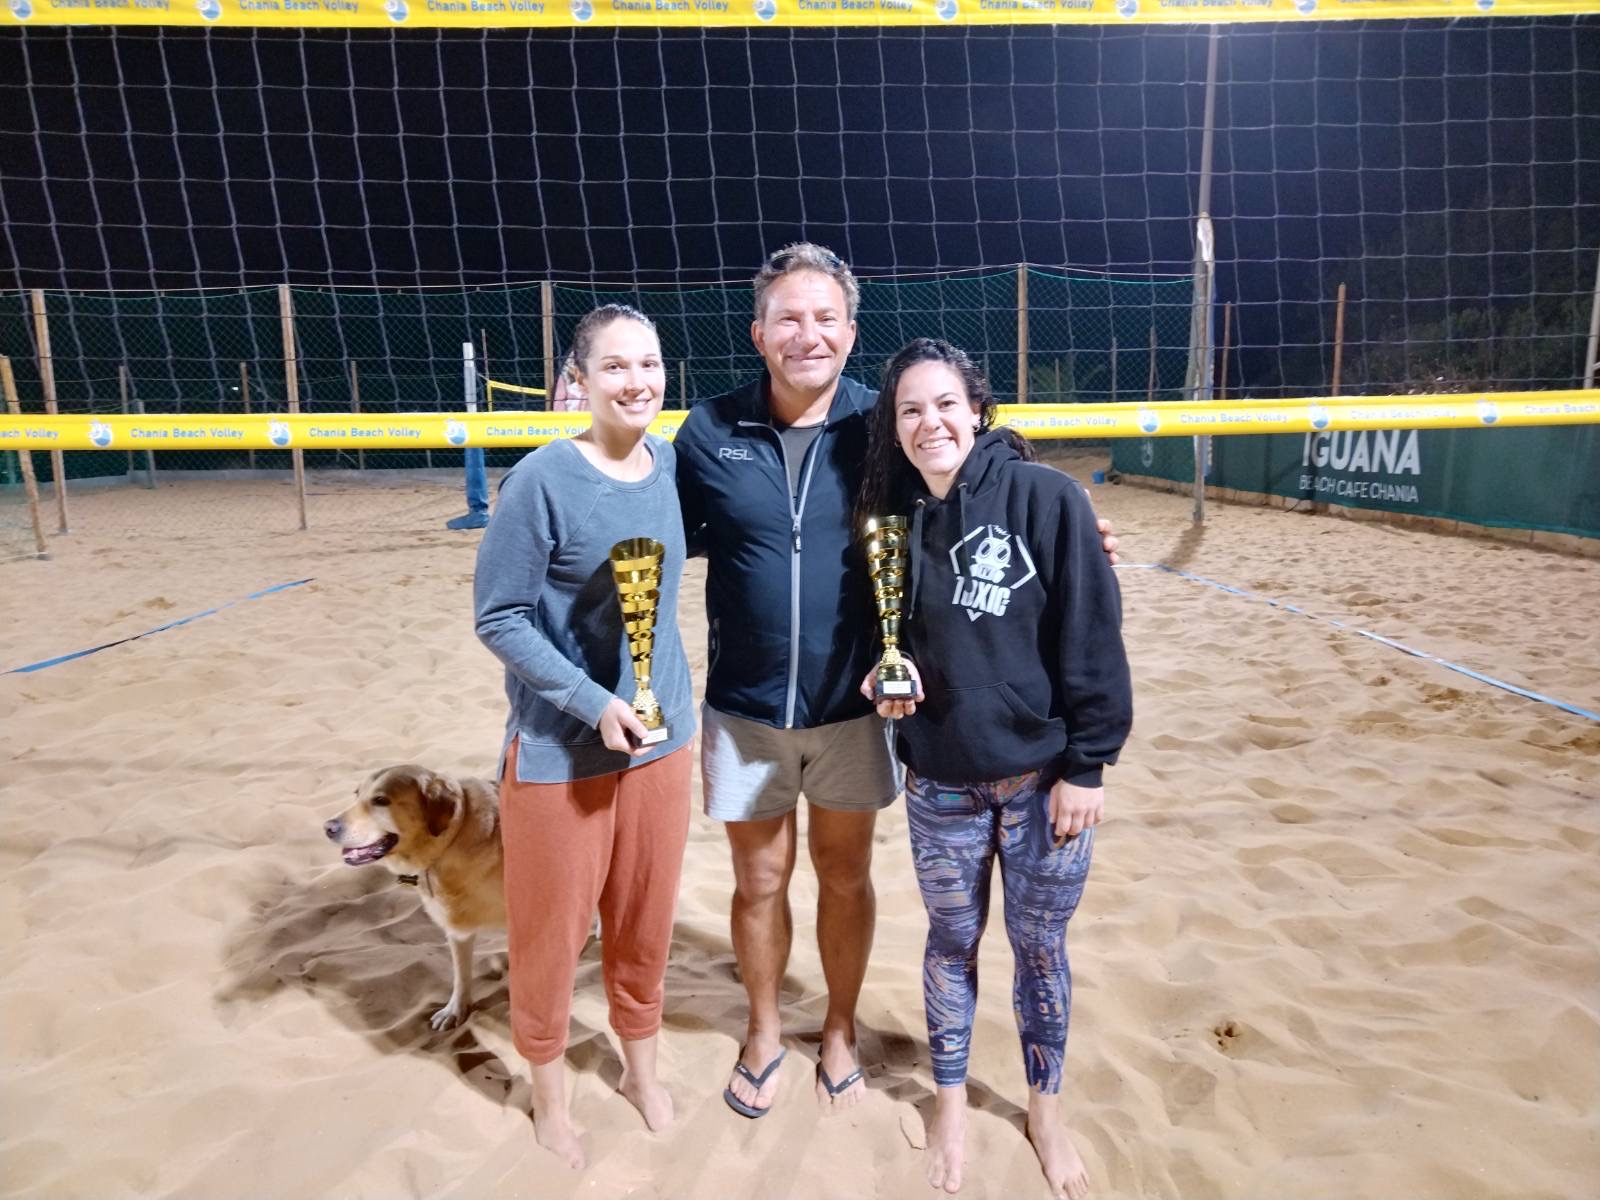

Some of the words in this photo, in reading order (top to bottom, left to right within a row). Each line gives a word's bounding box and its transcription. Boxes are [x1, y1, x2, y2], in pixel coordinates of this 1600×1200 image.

[51, 0, 90, 8] Chania
[94, 0, 130, 8] Beach
[134, 0, 170, 11] Volley
[240, 0, 279, 10] Chania
[285, 0, 320, 10] Beach
[325, 0, 358, 12] Volley
[427, 0, 466, 11] Chania
[472, 1, 505, 11] Beach
[511, 1, 544, 13] Volley
[613, 0, 650, 10] Chania
[656, 0, 689, 10] Beach
[695, 0, 728, 12] Volley
[799, 0, 836, 10] Chania
[842, 0, 874, 9] Beach
[880, 0, 912, 12] Volley
[980, 0, 1017, 9] Chania
[1023, 0, 1055, 9] Beach
[1061, 0, 1093, 11] Volley
[1010, 418, 1045, 428] Chania
[1050, 417, 1081, 426] Beach
[1086, 416, 1117, 427] Volley
[1180, 414, 1216, 423] Chania
[1220, 413, 1251, 422] Beach
[1256, 412, 1288, 423] Volley
[25, 428, 59, 440] Volley
[130, 428, 168, 438] Chania
[172, 428, 206, 438] Beach
[210, 428, 244, 440] Volley
[309, 428, 346, 437] Chania
[351, 427, 384, 437] Beach
[388, 427, 421, 439] Volley
[486, 426, 523, 436] Chania
[527, 426, 560, 435] Beach
[718, 447, 753, 461] RSL
[1302, 429, 1421, 475] IGUANA
[1299, 474, 1336, 494] BEACH
[1338, 479, 1369, 498] CAFE
[1370, 482, 1419, 503] CHANIA
